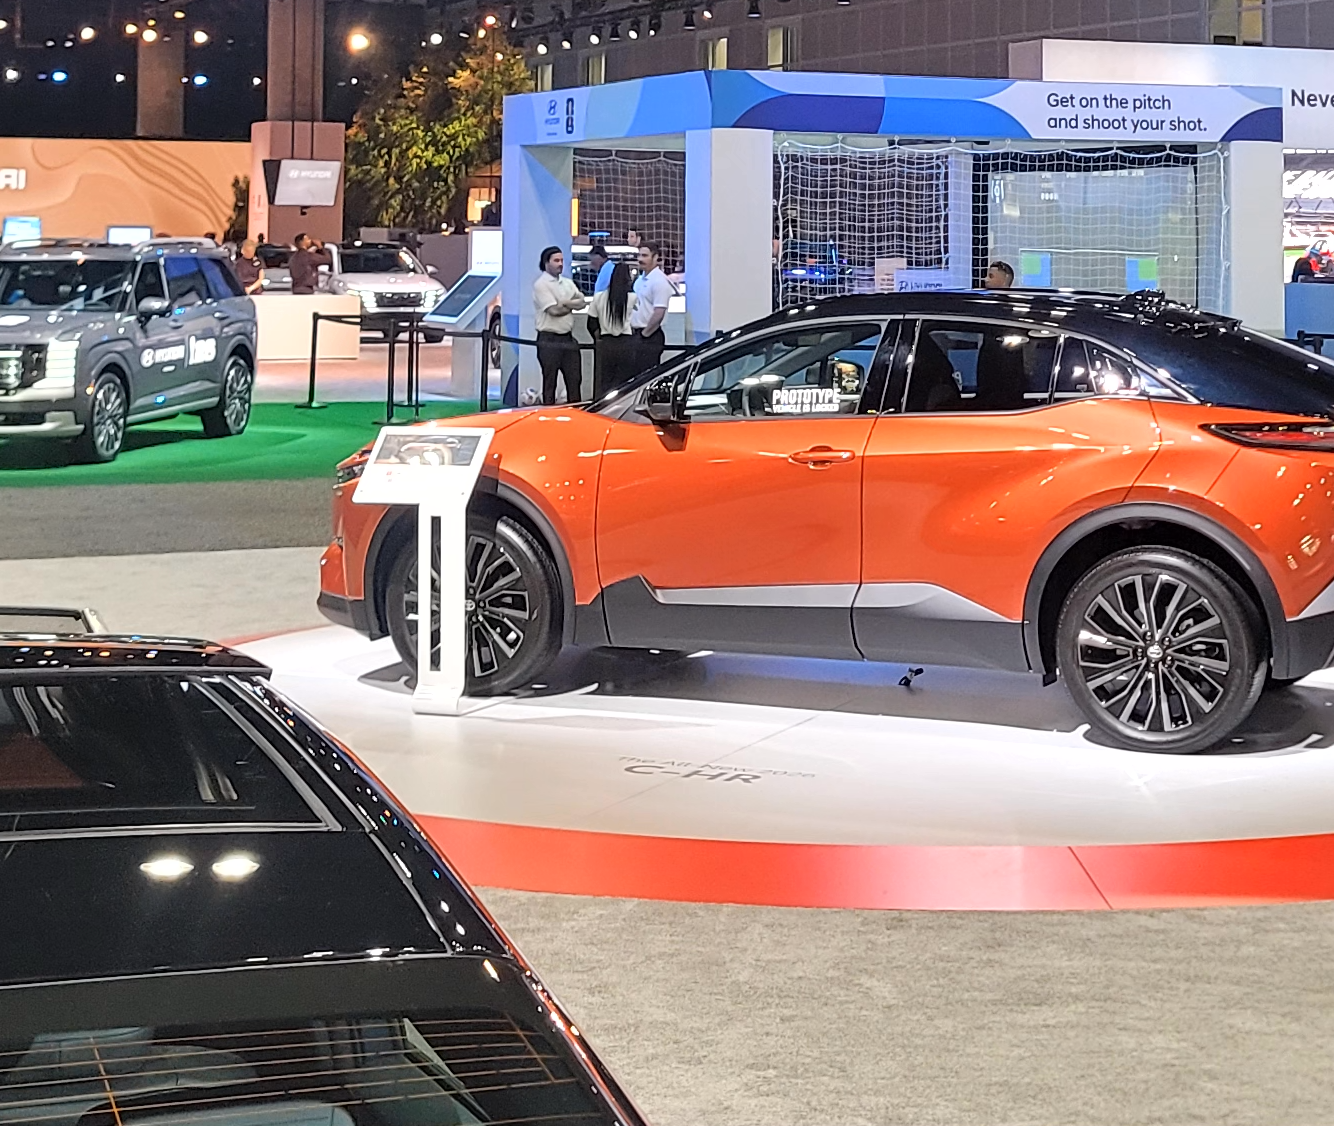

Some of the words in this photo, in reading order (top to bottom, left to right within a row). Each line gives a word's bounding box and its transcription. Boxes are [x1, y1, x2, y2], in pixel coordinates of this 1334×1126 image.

[1046, 92, 1075, 109] Get
[1079, 96, 1100, 109] on
[1103, 93, 1129, 110] the
[1132, 94, 1172, 113] pitch
[1046, 114, 1079, 130] and
[1082, 115, 1128, 131] shoot
[1131, 118, 1166, 134] your
[1169, 116, 1208, 133] shot.
[772, 388, 841, 405] PROTOTYPE
[772, 403, 802, 414] VEHICLE
[802, 403, 811, 413] IS
[812, 402, 840, 412] LOCKED
[618, 755, 656, 764] The
[623, 764, 763, 784] C-HR
